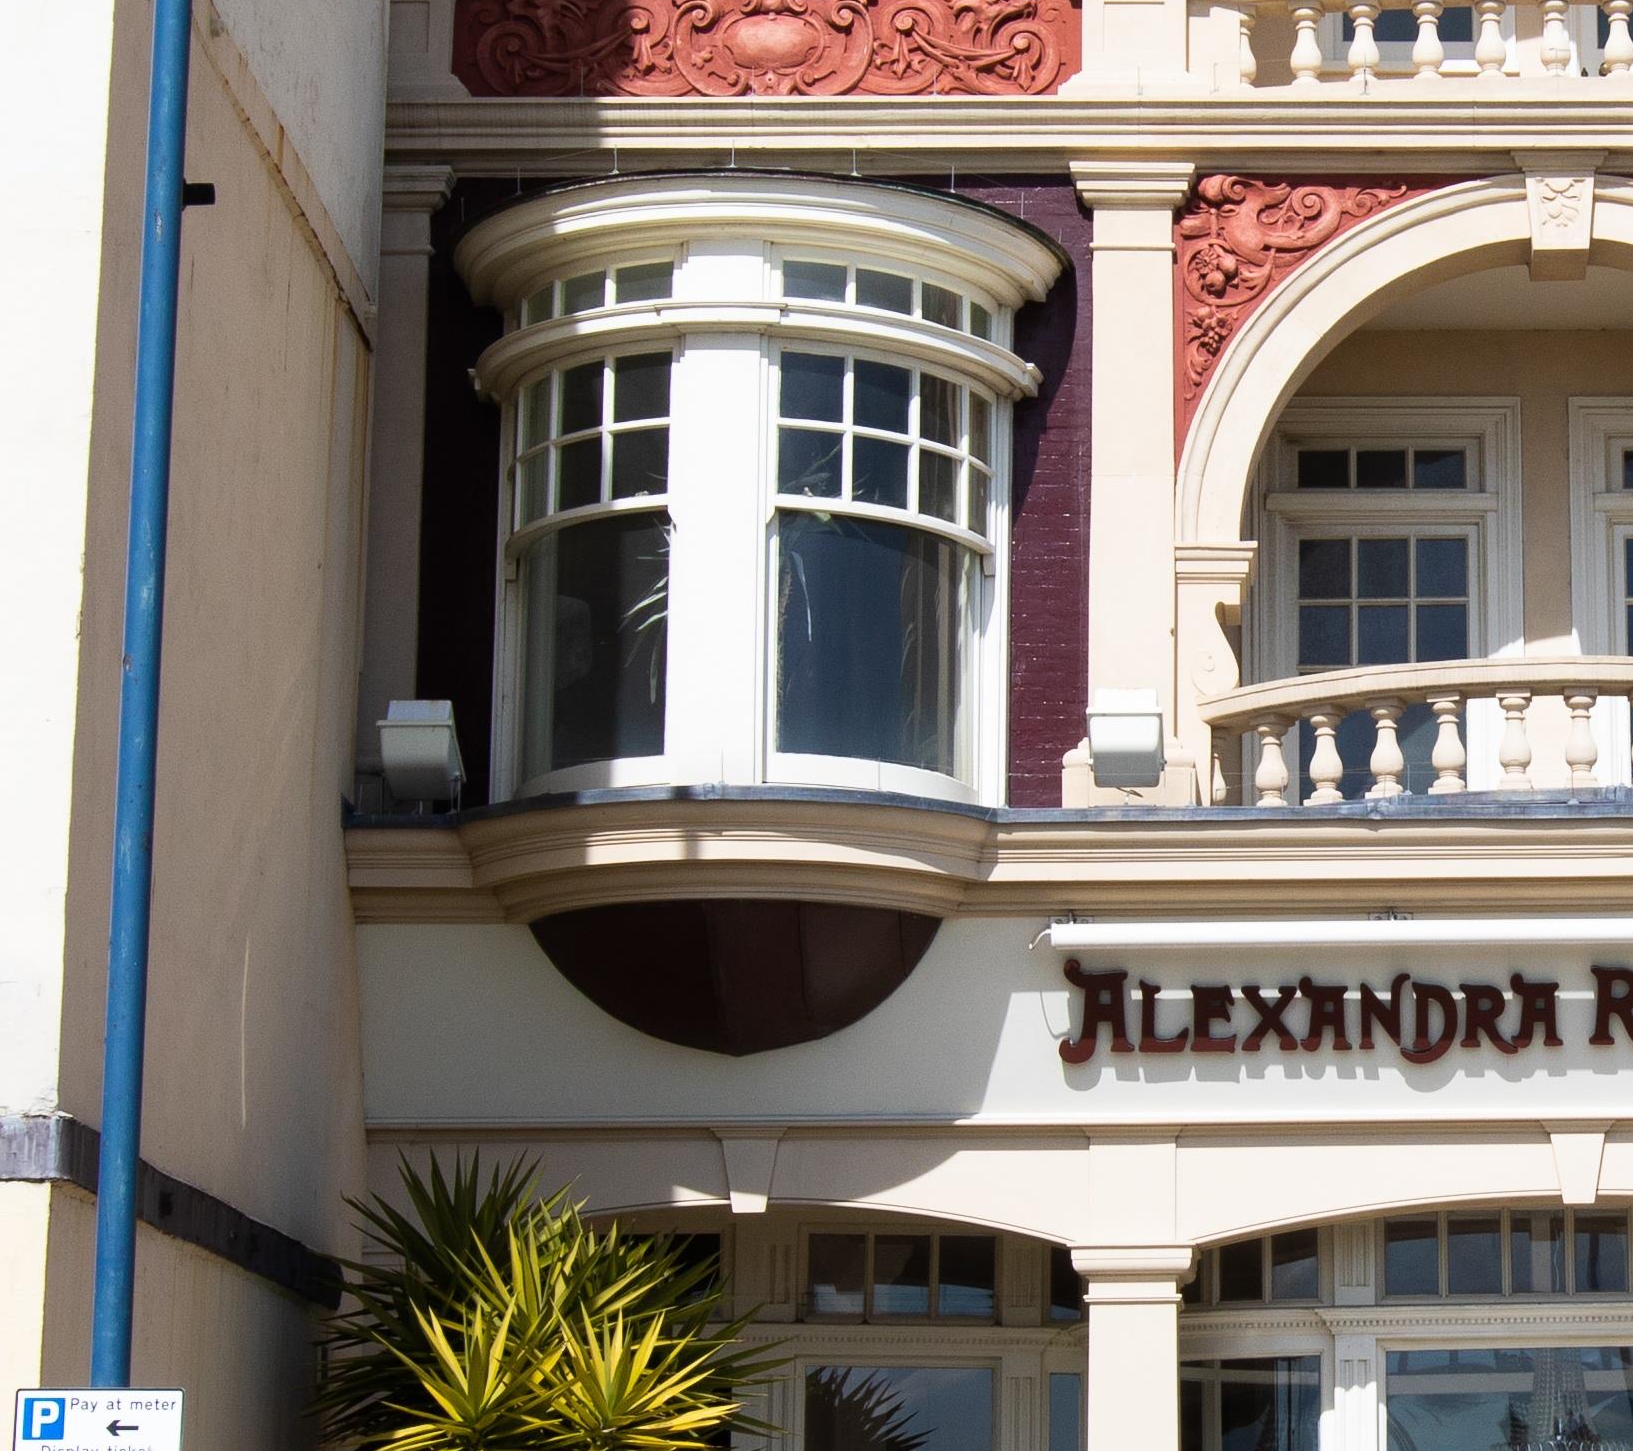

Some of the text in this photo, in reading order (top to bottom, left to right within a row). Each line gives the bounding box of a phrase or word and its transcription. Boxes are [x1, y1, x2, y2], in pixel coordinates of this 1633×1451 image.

[1059, 960, 1564, 1064] ALEXANDRA
[32, 1400, 60, 1438] P
[70, 1398, 177, 1413] Pay at meter
